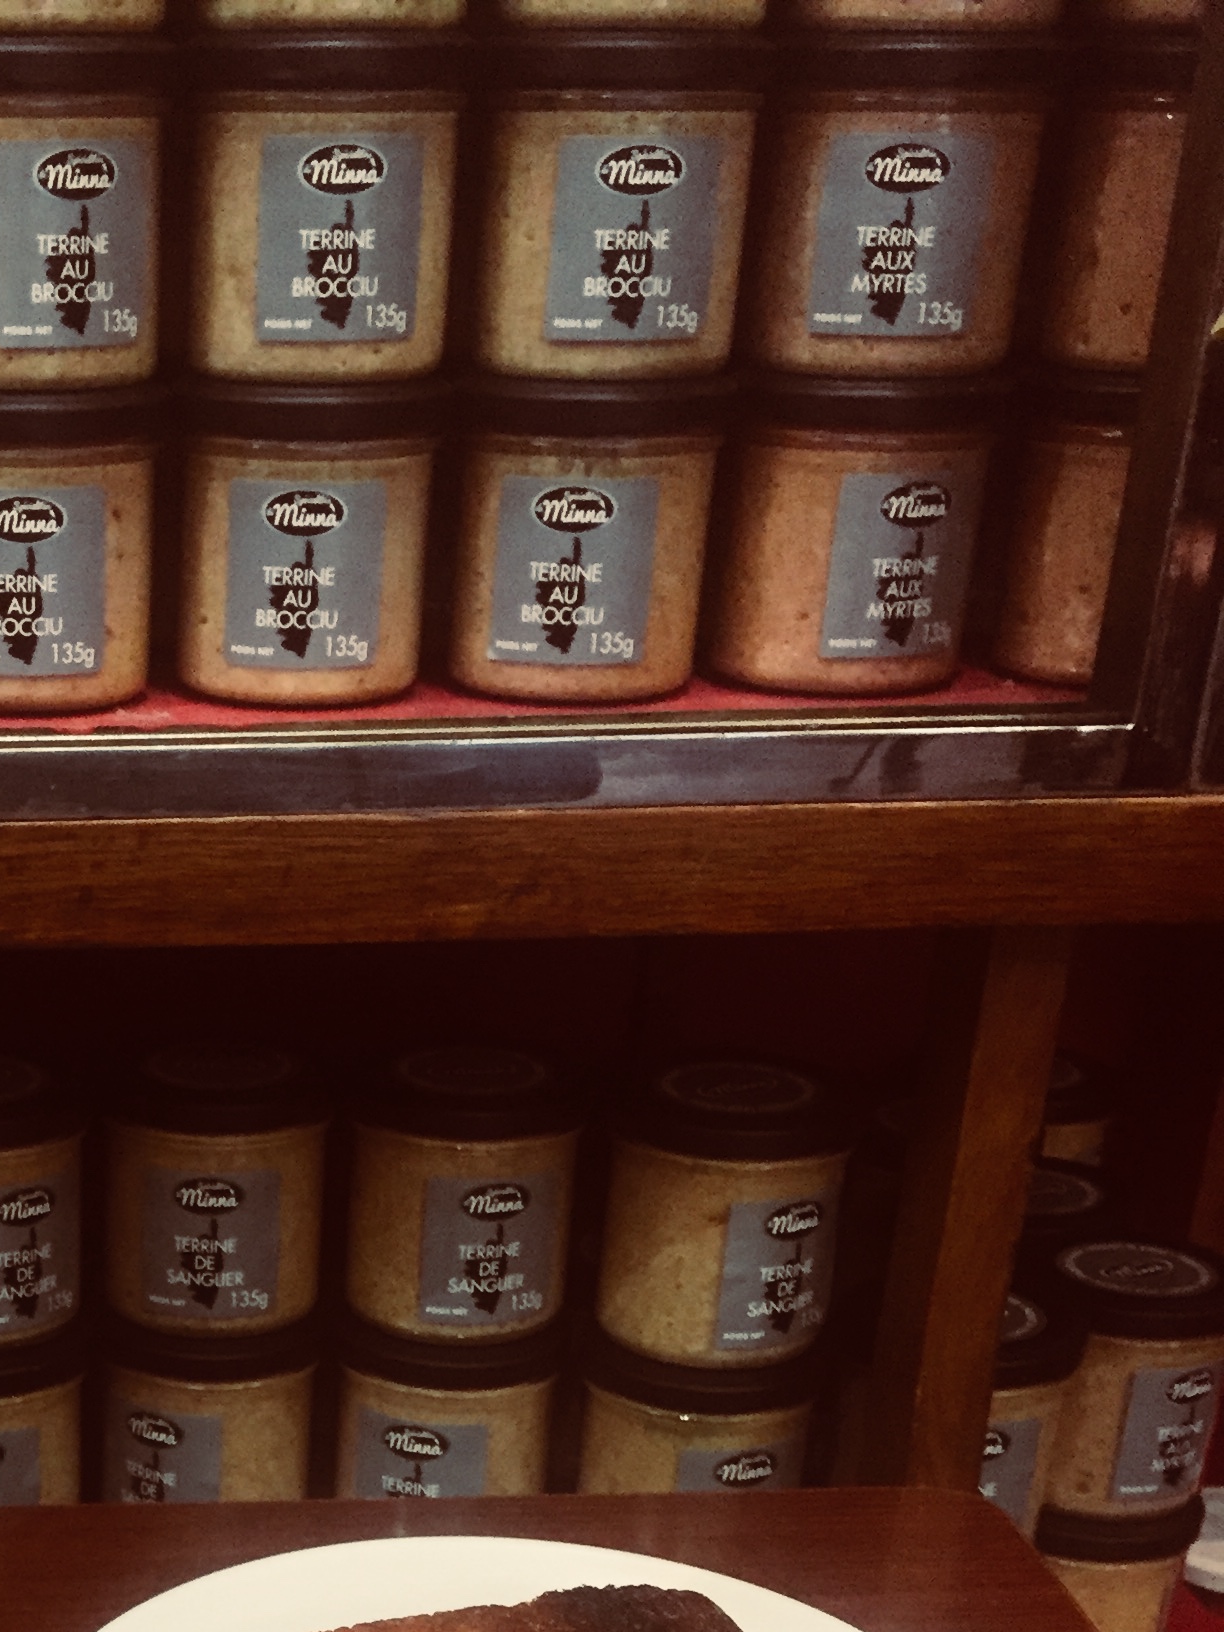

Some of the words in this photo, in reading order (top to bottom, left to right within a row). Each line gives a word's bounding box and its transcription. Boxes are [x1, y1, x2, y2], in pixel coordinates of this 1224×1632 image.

[36, 232, 109, 255] TERRINE
[299, 229, 376, 251] TERRINE
[594, 229, 671, 251] TERRINE
[856, 226, 936, 249] TERRINE
[60, 258, 89, 279] AU
[321, 254, 353, 275] AU
[614, 254, 646, 275] AU
[871, 250, 915, 271] AUX
[31, 281, 114, 303] BROCCIU
[291, 276, 379, 299] BROCCIU
[583, 276, 672, 299] BROCCIU
[850, 272, 928, 295] MYRTES
[102, 309, 138, 337] 135g
[365, 304, 408, 333] 135g
[656, 304, 698, 333] 135g
[917, 301, 964, 330] 135g
[263, 566, 336, 587] TERRINE
[530, 561, 604, 583] TERRINE
[871, 556, 940, 579] TERRINE
[283, 590, 313, 608] AU
[548, 585, 579, 604] AU
[885, 579, 922, 599] AUX
[7, 597, 37, 615] AU
[520, 604, 605, 625] BROCCIU
[255, 609, 340, 630] BROCCIU
[50, 642, 96, 668] 135g
[324, 635, 369, 662] 135g
[589, 632, 635, 659] 135g
[174, 1236, 237, 1254] TERRINE
[459, 1241, 520, 1261] TERRINE
[17, 1267, 35, 1282] DE
[195, 1256, 216, 1271] DE
[479, 1260, 501, 1278] DE
[759, 1257, 814, 1284] TERRINE
[777, 1280, 796, 1298] DE
